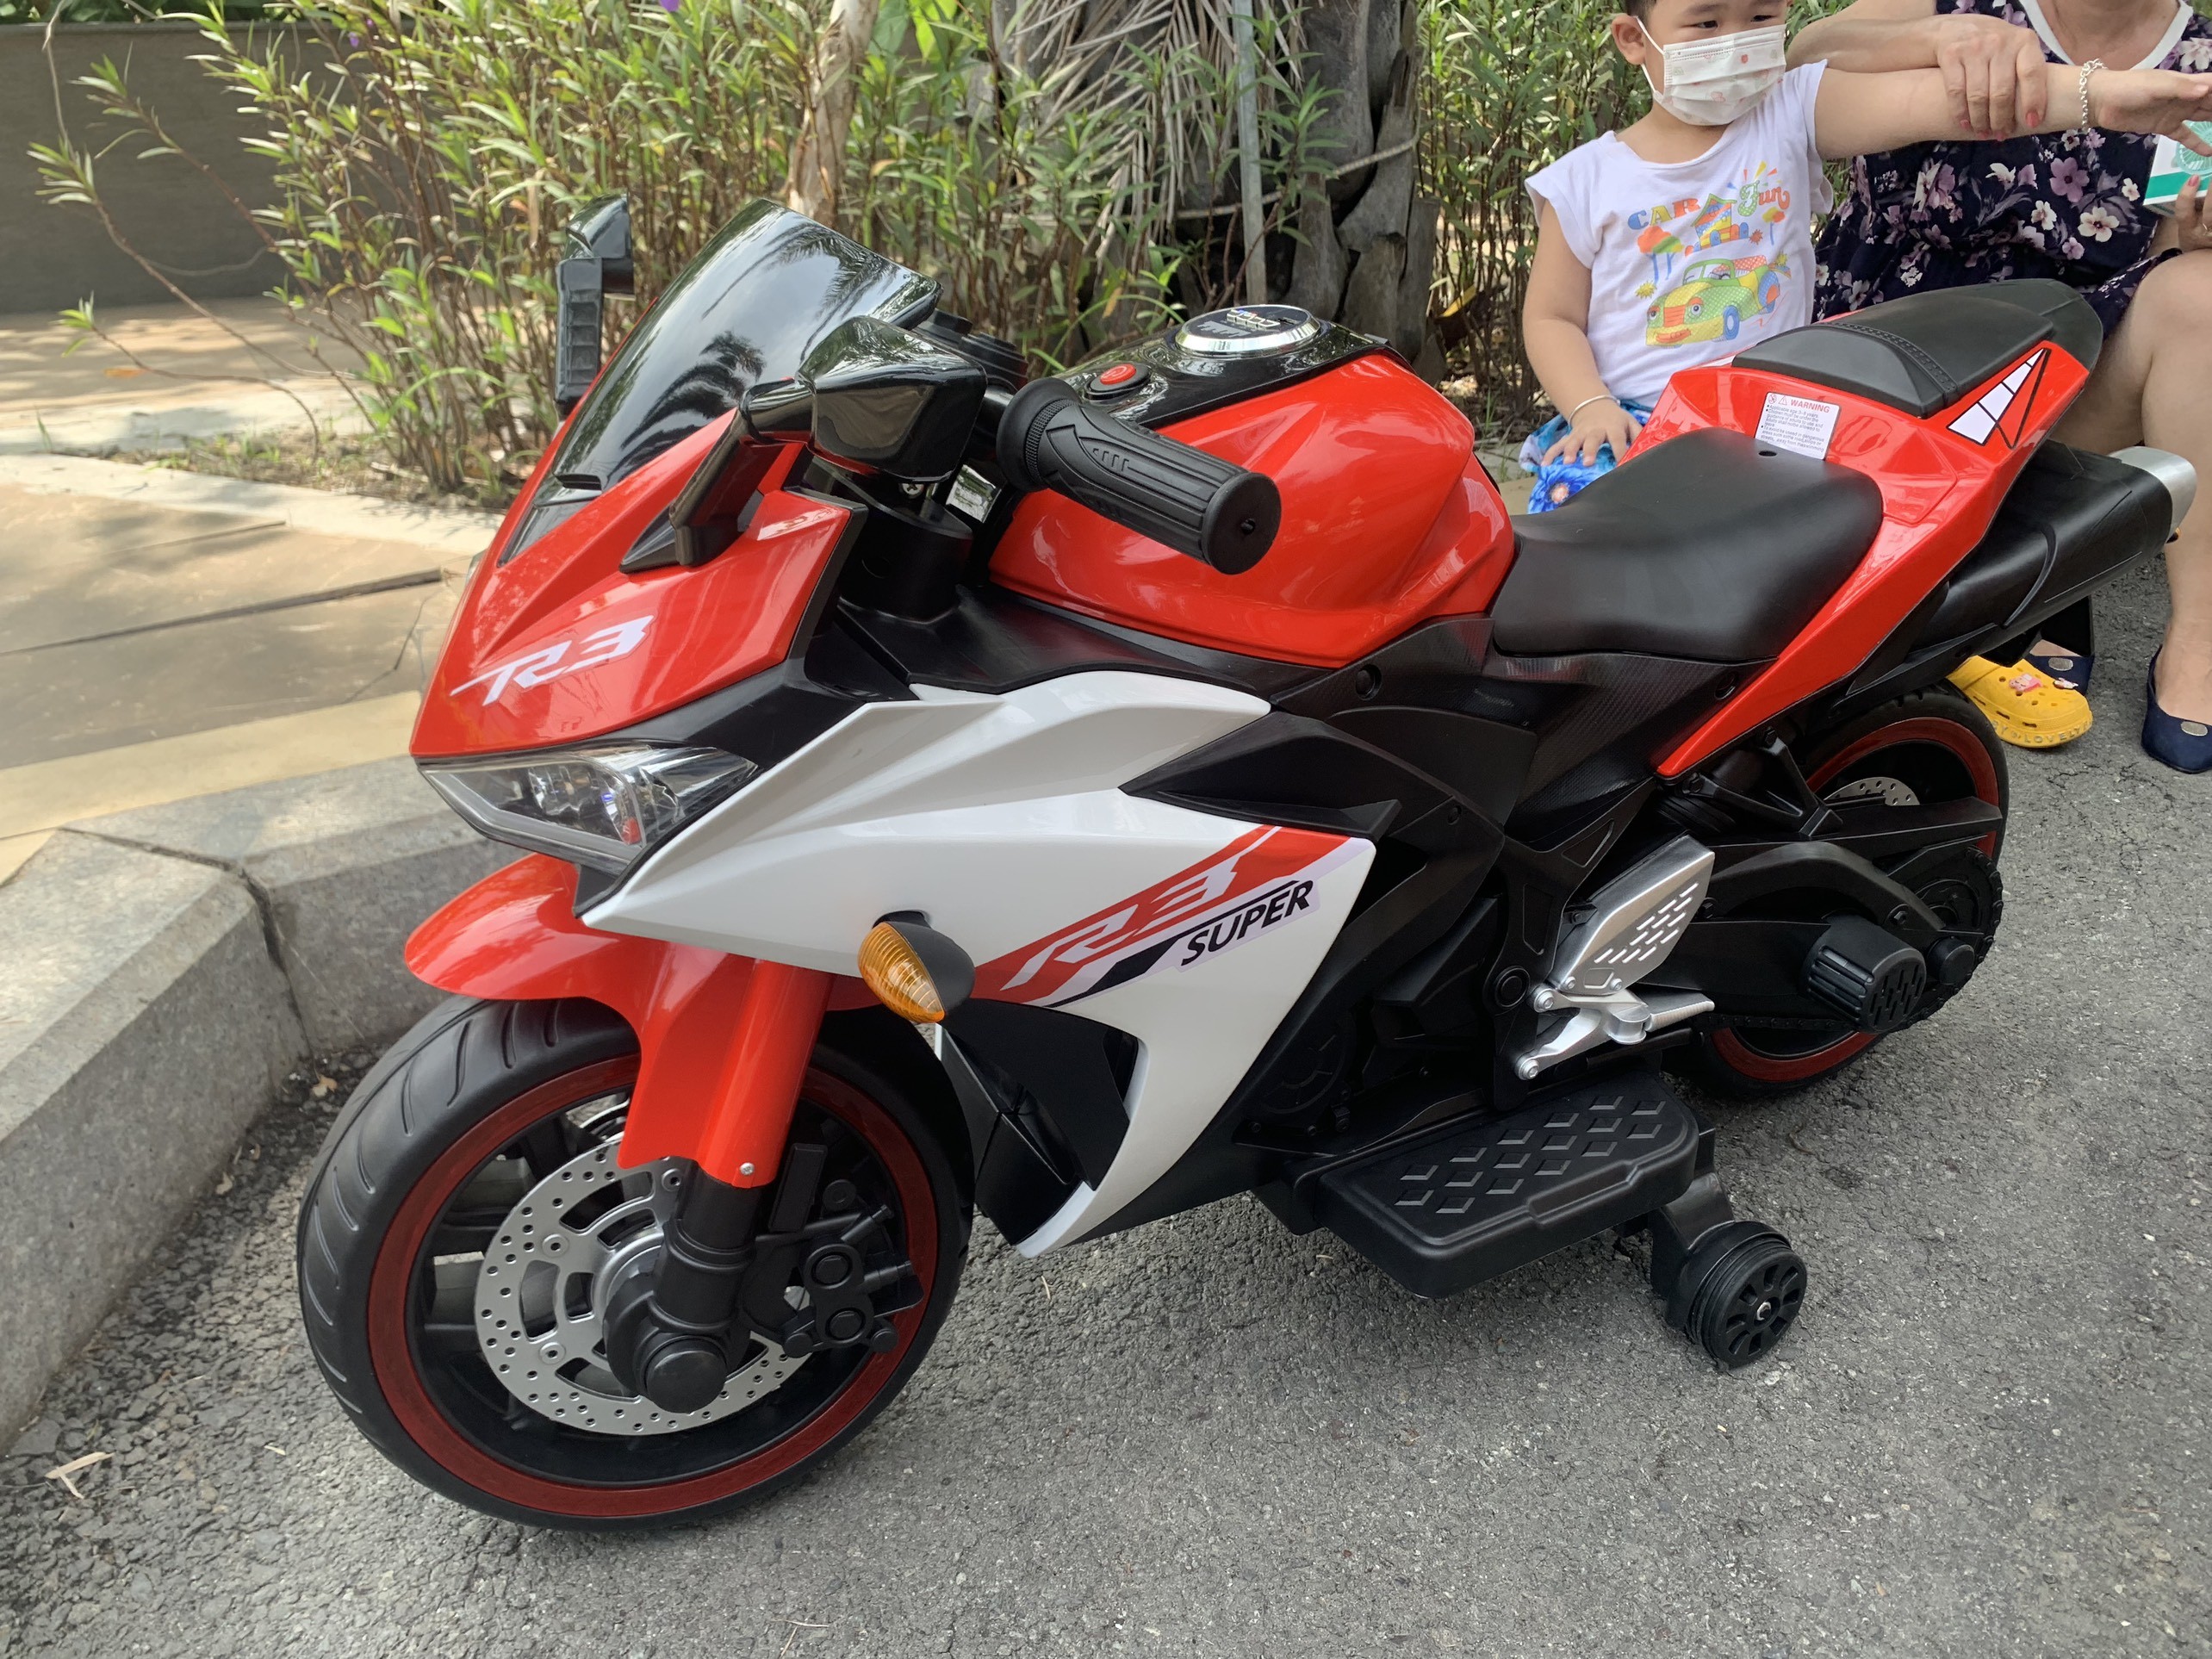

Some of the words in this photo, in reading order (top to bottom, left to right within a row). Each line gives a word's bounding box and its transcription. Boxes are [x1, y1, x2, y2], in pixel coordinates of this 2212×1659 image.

[1628, 197, 1700, 230] CAR
[1737, 179, 1790, 216] Fun
[1790, 399, 1830, 413] WARNING
[450, 615, 654, 705] R3
[999, 853, 1240, 991] R3
[1181, 879, 1314, 966] SUPER
